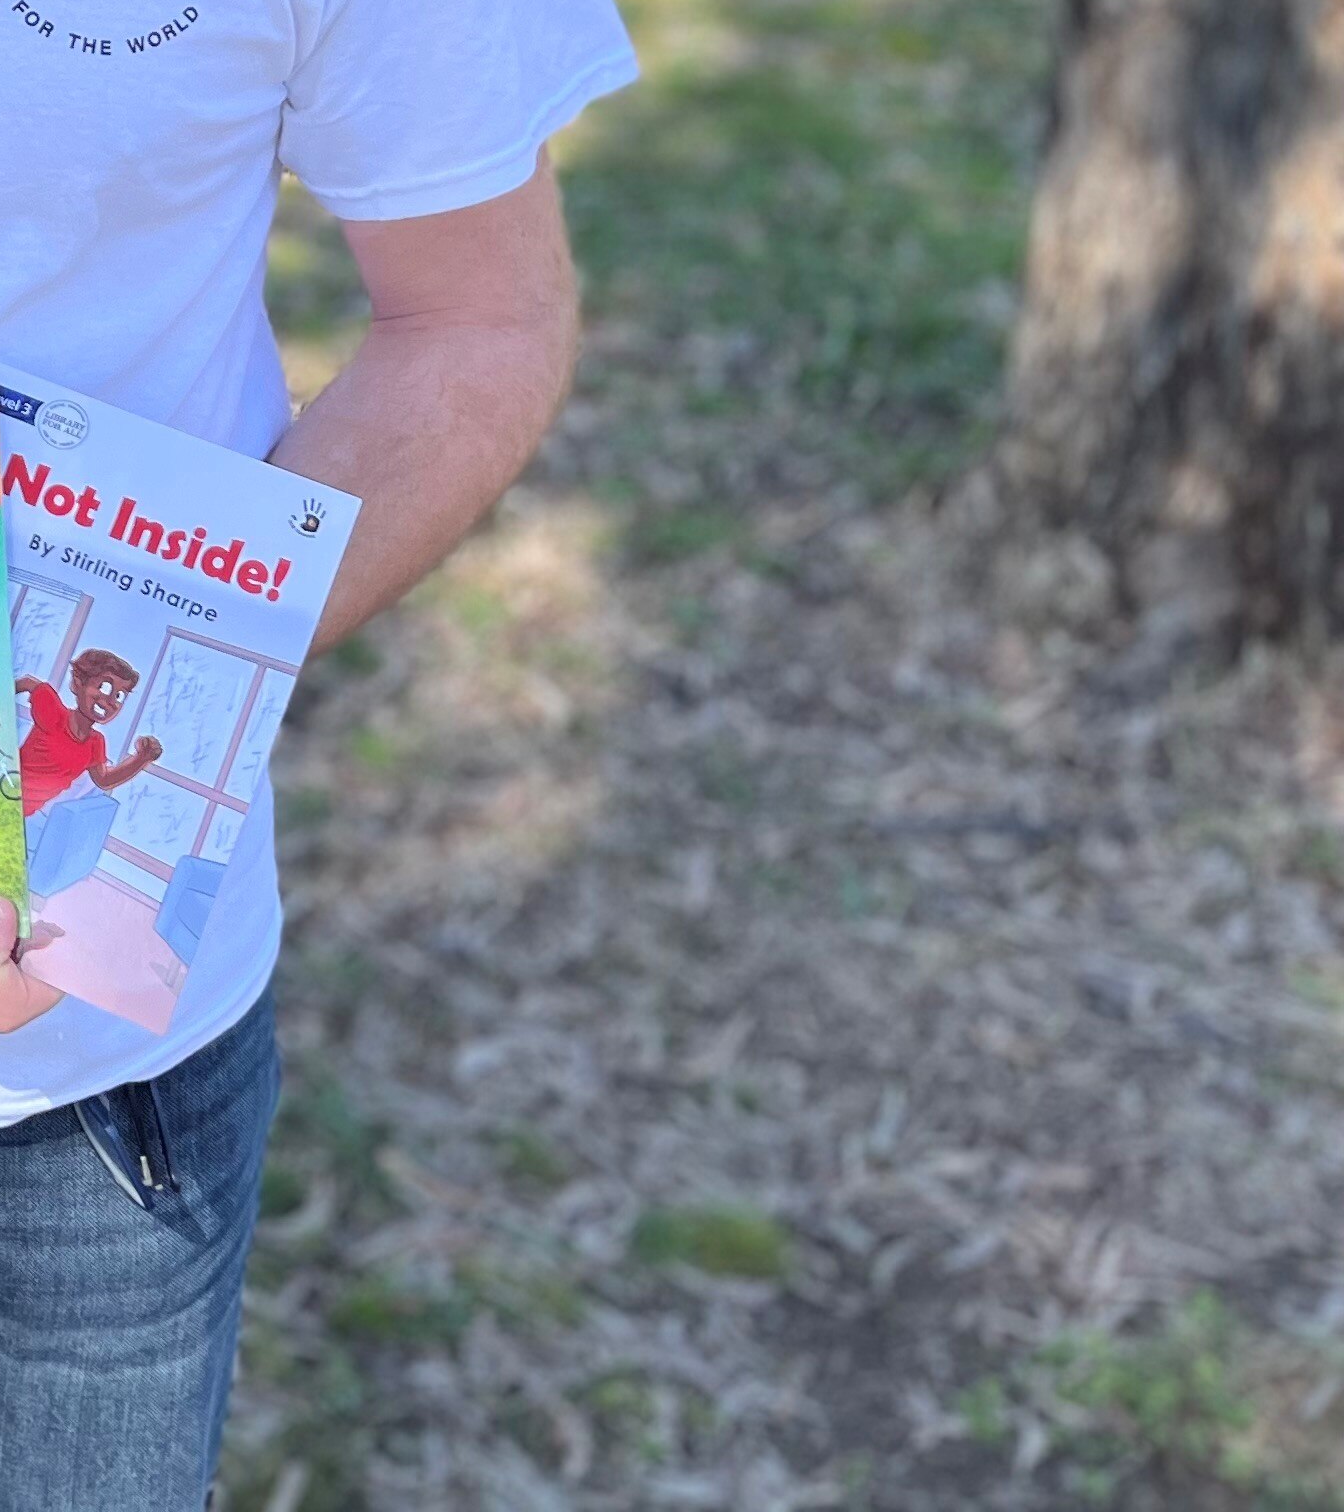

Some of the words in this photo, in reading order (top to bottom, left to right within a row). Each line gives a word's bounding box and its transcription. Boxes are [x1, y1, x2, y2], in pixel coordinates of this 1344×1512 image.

[12, 0, 54, 37] FOR
[68, 33, 111, 55] THE
[126, 6, 198, 54] WORLD
[21, 402, 33, 415] 3
[2, 453, 101, 529] Not
[109, 496, 292, 603] Inside!
[29, 533, 55, 558] By
[61, 546, 133, 592] Stirling
[140, 579, 218, 622] Sharpe
